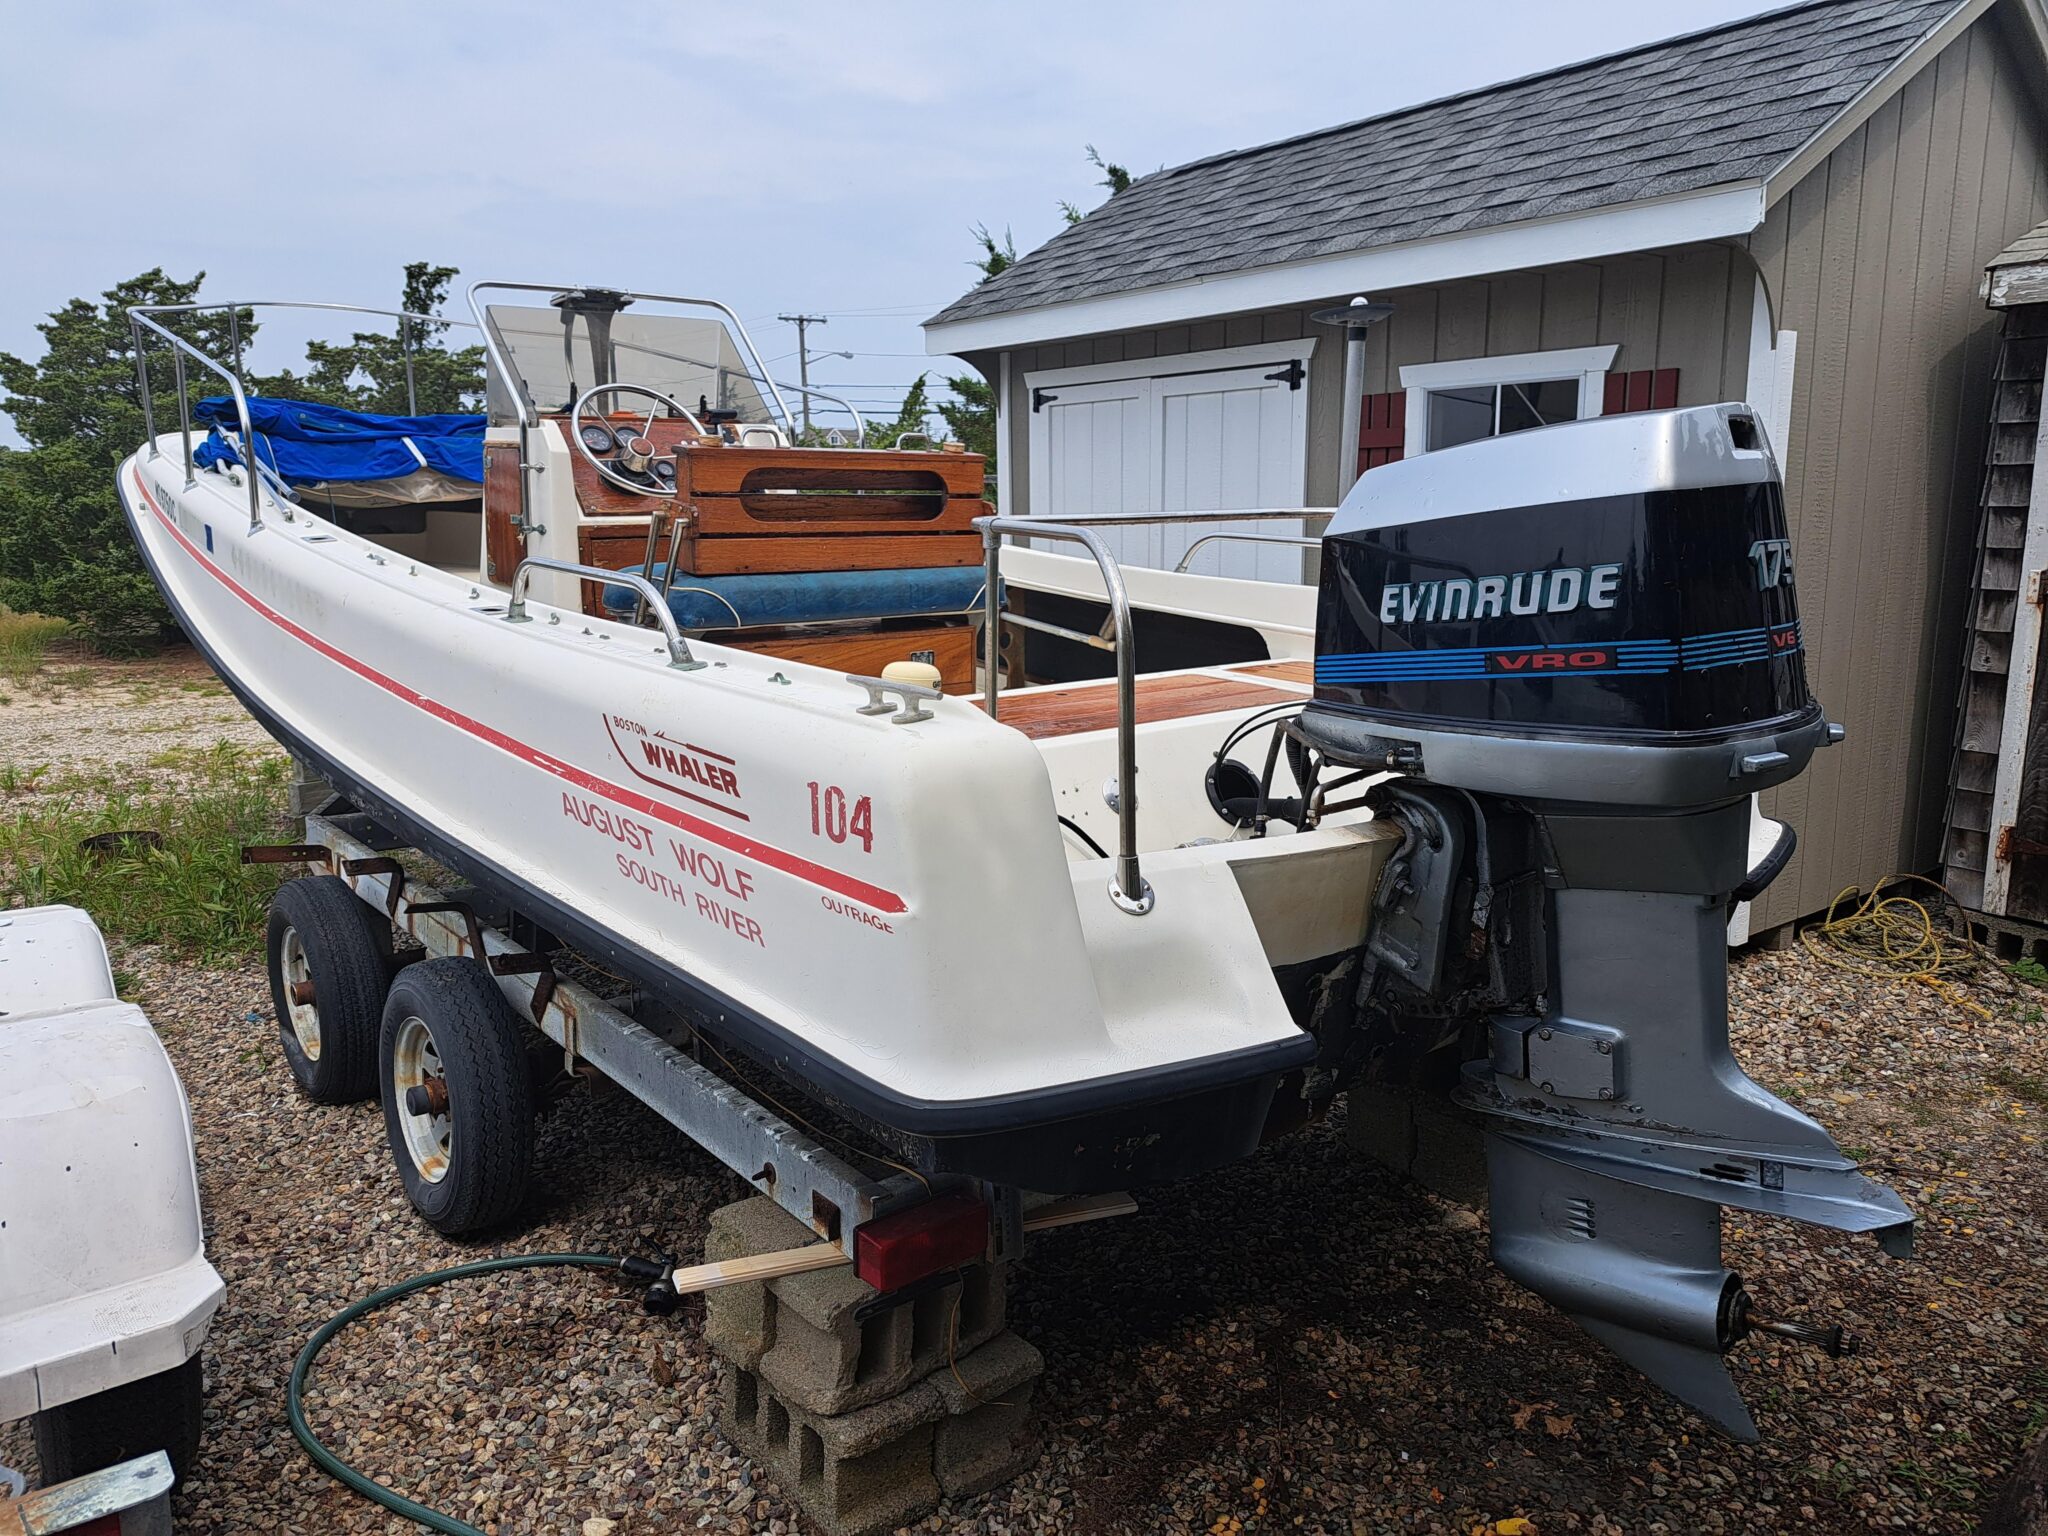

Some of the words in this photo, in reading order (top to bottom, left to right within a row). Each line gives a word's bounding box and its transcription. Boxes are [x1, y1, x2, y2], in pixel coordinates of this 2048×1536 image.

[1748, 539, 1793, 591] 175
[1379, 563, 1623, 624] EVINRUDE
[1496, 651, 1607, 669] VRO
[1773, 631, 1796, 647] V6
[613, 715, 648, 737] BOSTON
[640, 740, 742, 799] WHALER
[807, 781, 874, 853] 104
[562, 792, 655, 855] AUGUST
[669, 838, 755, 901] WOLF
[616, 853, 687, 906] SOUTH
[695, 892, 766, 948] RIVER
[821, 896, 895, 934] OUTRAGE
